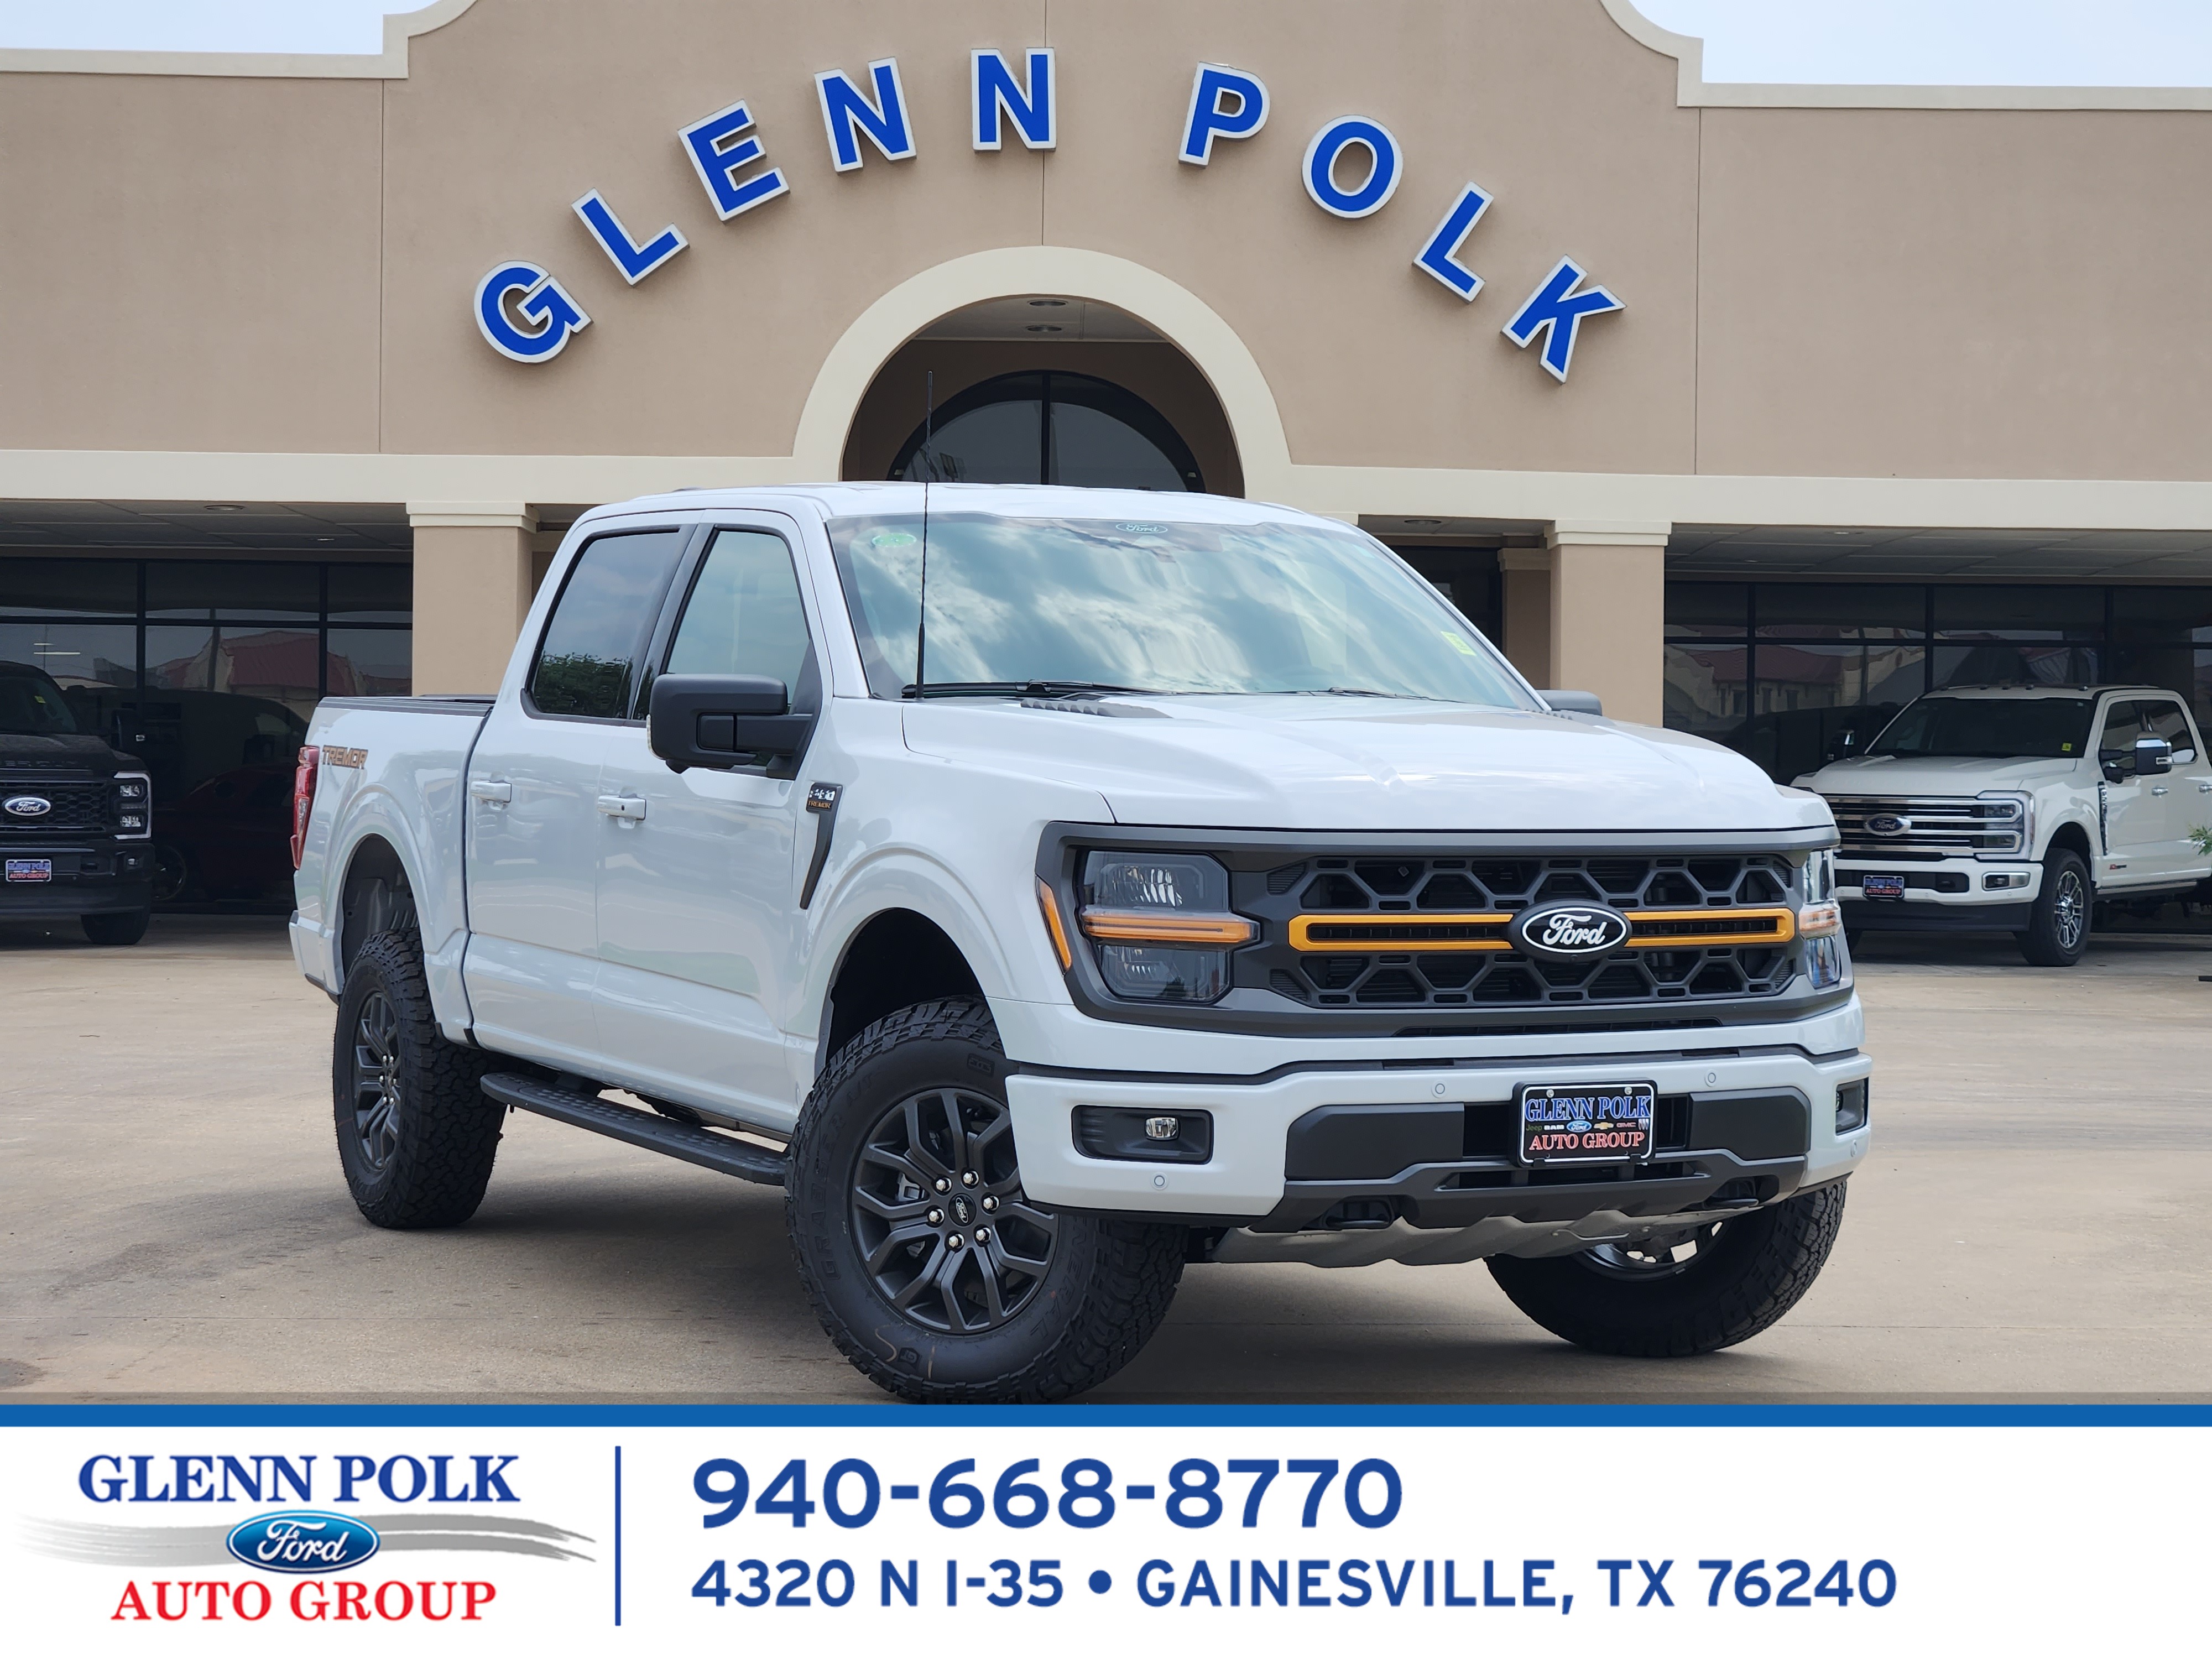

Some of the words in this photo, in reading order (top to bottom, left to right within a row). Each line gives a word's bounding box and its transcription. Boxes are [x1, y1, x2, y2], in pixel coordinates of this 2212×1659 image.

[474, 48, 1056, 363] GLENN
[1179, 62, 1625, 382] POLK
[322, 744, 368, 770] TREMOR
[16, 801, 41, 812] Ford
[808, 800, 831, 809] TREMOR
[1875, 819, 1896, 829] Ford
[1543, 914, 1607, 945] Ford
[1525, 1097, 1594, 1121] GLENN
[1597, 1095, 1651, 1119] POLK
[1529, 1134, 1579, 1150] AUTO
[1582, 1132, 1645, 1149] GROUP
[1030, 1217, 1087, 1339] ENERAL
